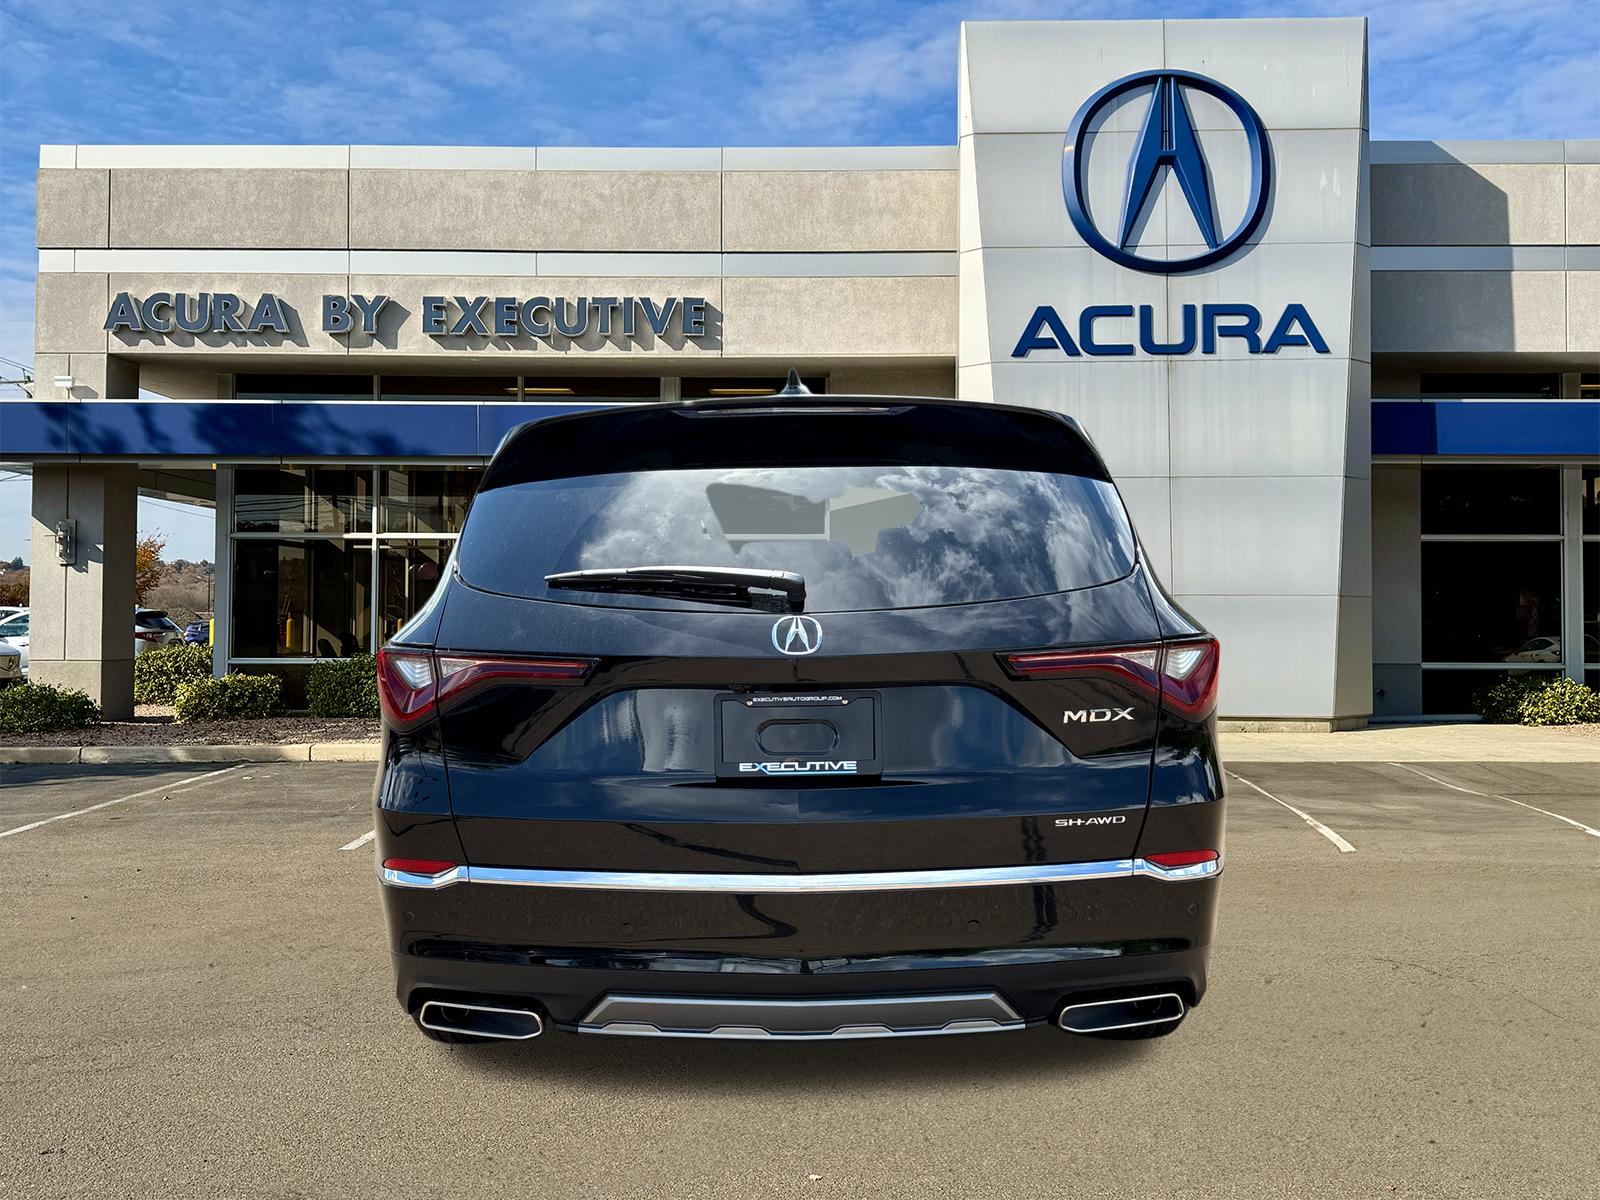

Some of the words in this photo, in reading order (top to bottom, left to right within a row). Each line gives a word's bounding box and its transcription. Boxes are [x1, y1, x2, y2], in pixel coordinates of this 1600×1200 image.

[104, 292, 290, 333] ACURA
[322, 294, 390, 334] BY
[422, 296, 706, 337] EXECUTIVE
[1010, 303, 1331, 357] ACURA
[1063, 707, 1136, 724] MDX
[739, 761, 857, 773] EXECUTIVE
[1055, 815, 1126, 827] SH-AWD
